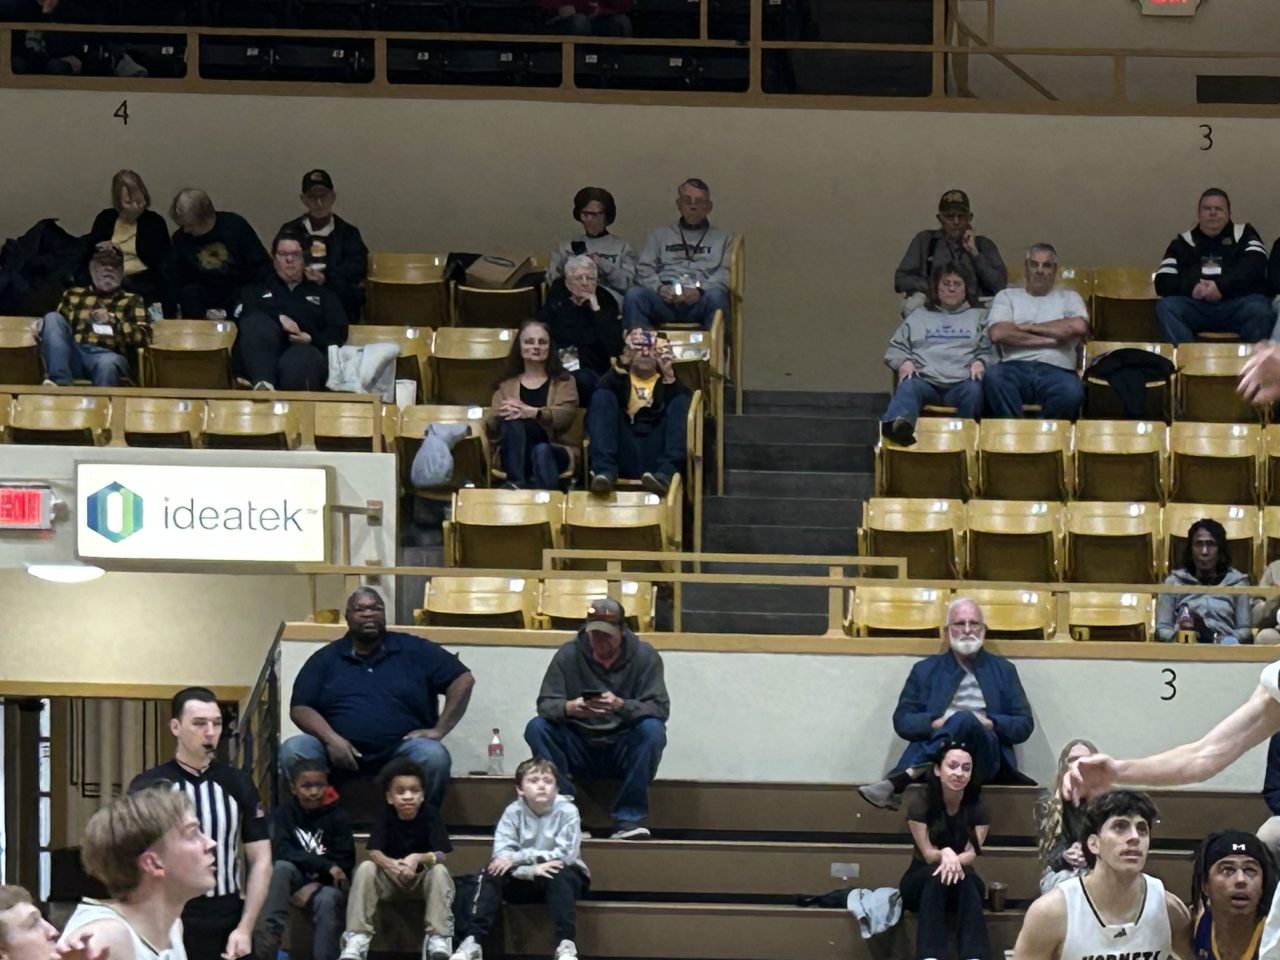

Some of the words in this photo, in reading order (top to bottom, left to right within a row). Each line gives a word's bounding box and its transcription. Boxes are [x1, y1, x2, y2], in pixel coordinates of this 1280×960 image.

[113, 99, 129, 126] 4
[1199, 124, 1213, 151] 3
[164, 498, 303, 532] ideatek
[1160, 668, 1177, 701] 3
